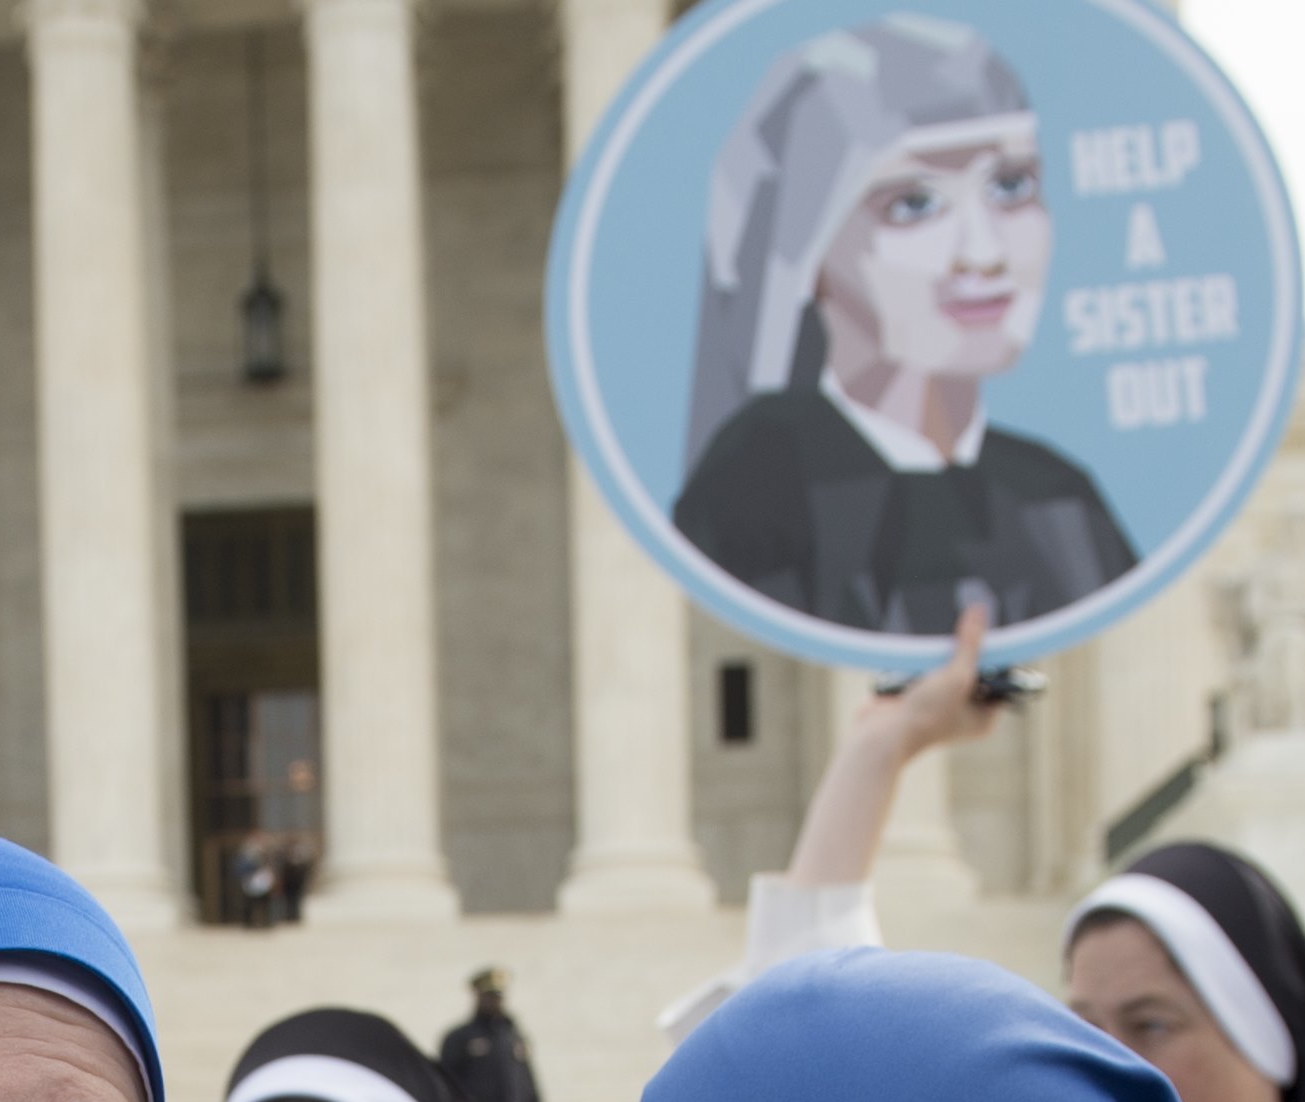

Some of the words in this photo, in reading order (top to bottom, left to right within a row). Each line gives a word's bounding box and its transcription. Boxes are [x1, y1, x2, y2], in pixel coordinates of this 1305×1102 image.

[1071, 119, 1199, 195] HELP
[1126, 202, 1166, 268] A
[1064, 274, 1238, 353] SISTER
[1107, 356, 1207, 428] OUT
